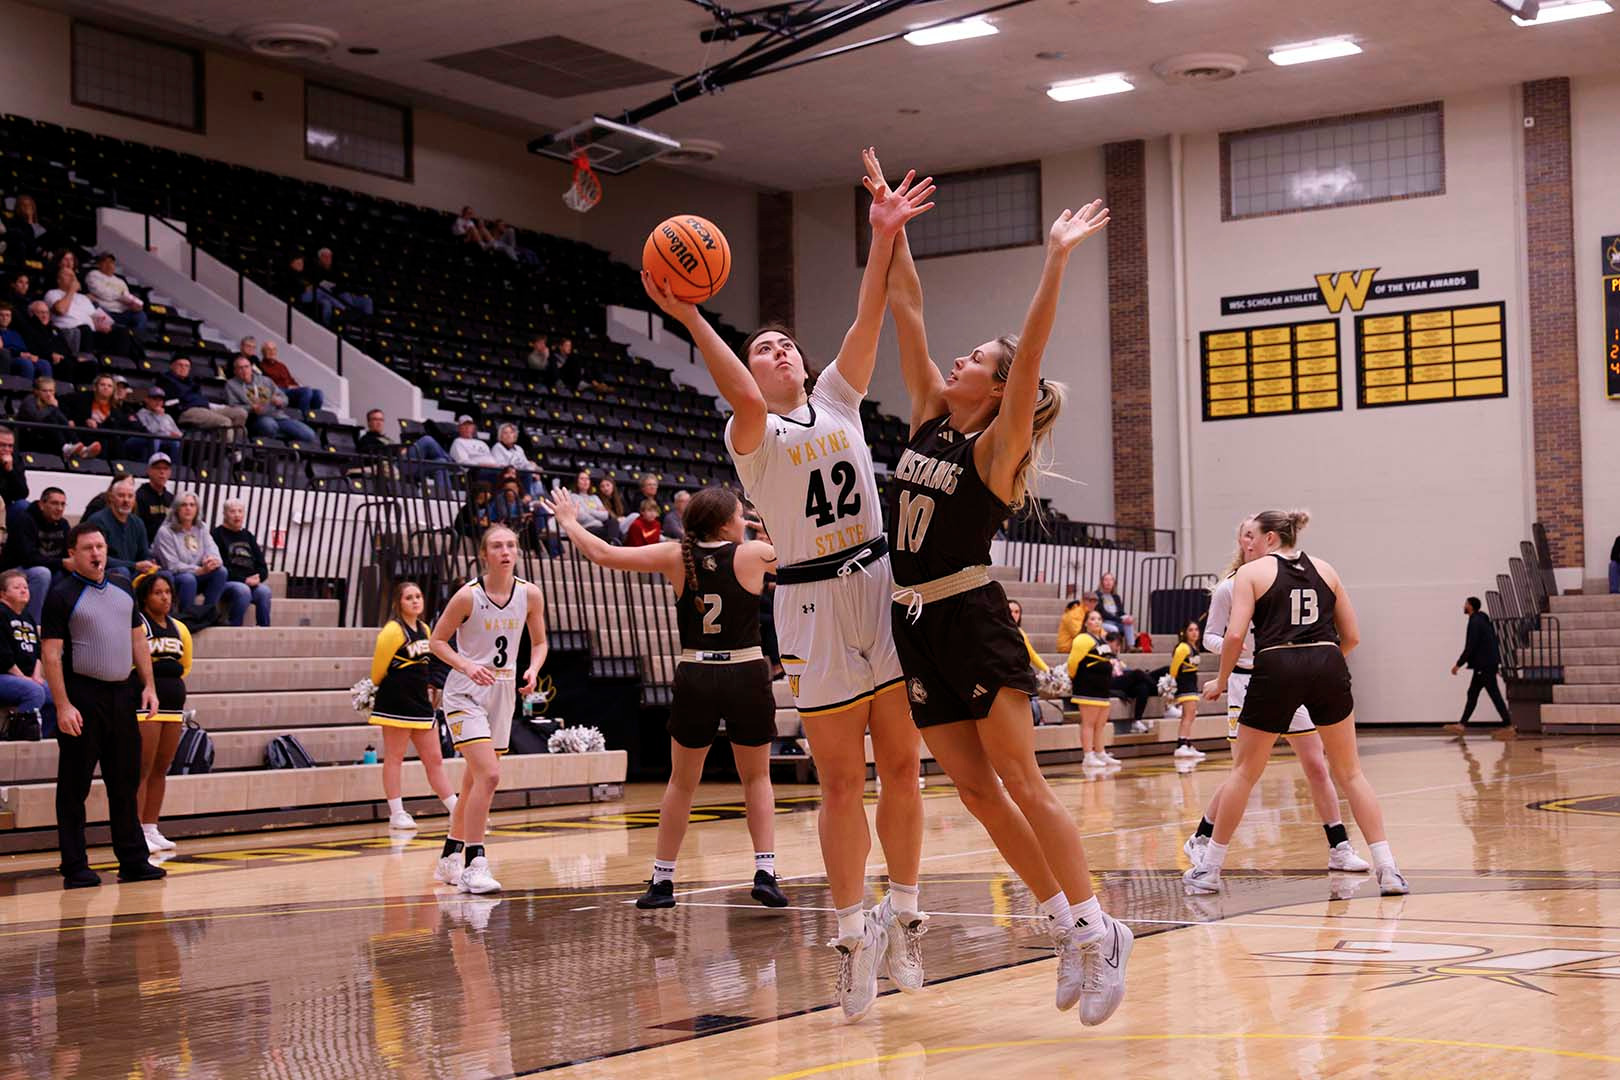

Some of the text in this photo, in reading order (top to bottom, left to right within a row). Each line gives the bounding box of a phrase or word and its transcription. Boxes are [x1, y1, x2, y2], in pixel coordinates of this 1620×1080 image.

[661, 224, 699, 274] Wilson
[1228, 276, 1467, 310] WSC SCHOLAR ATHLETE OF THE YEAR AWARDS
[1314, 266, 1383, 314] W
[786, 429, 850, 466] WAYNE
[805, 460, 861, 528] 42
[896, 489, 935, 553] 10
[815, 524, 866, 557] STATE
[484, 618, 520, 631] WAYNE
[703, 593, 722, 634] 2
[1289, 588, 1319, 625] 13
[493, 635, 508, 668] 3
